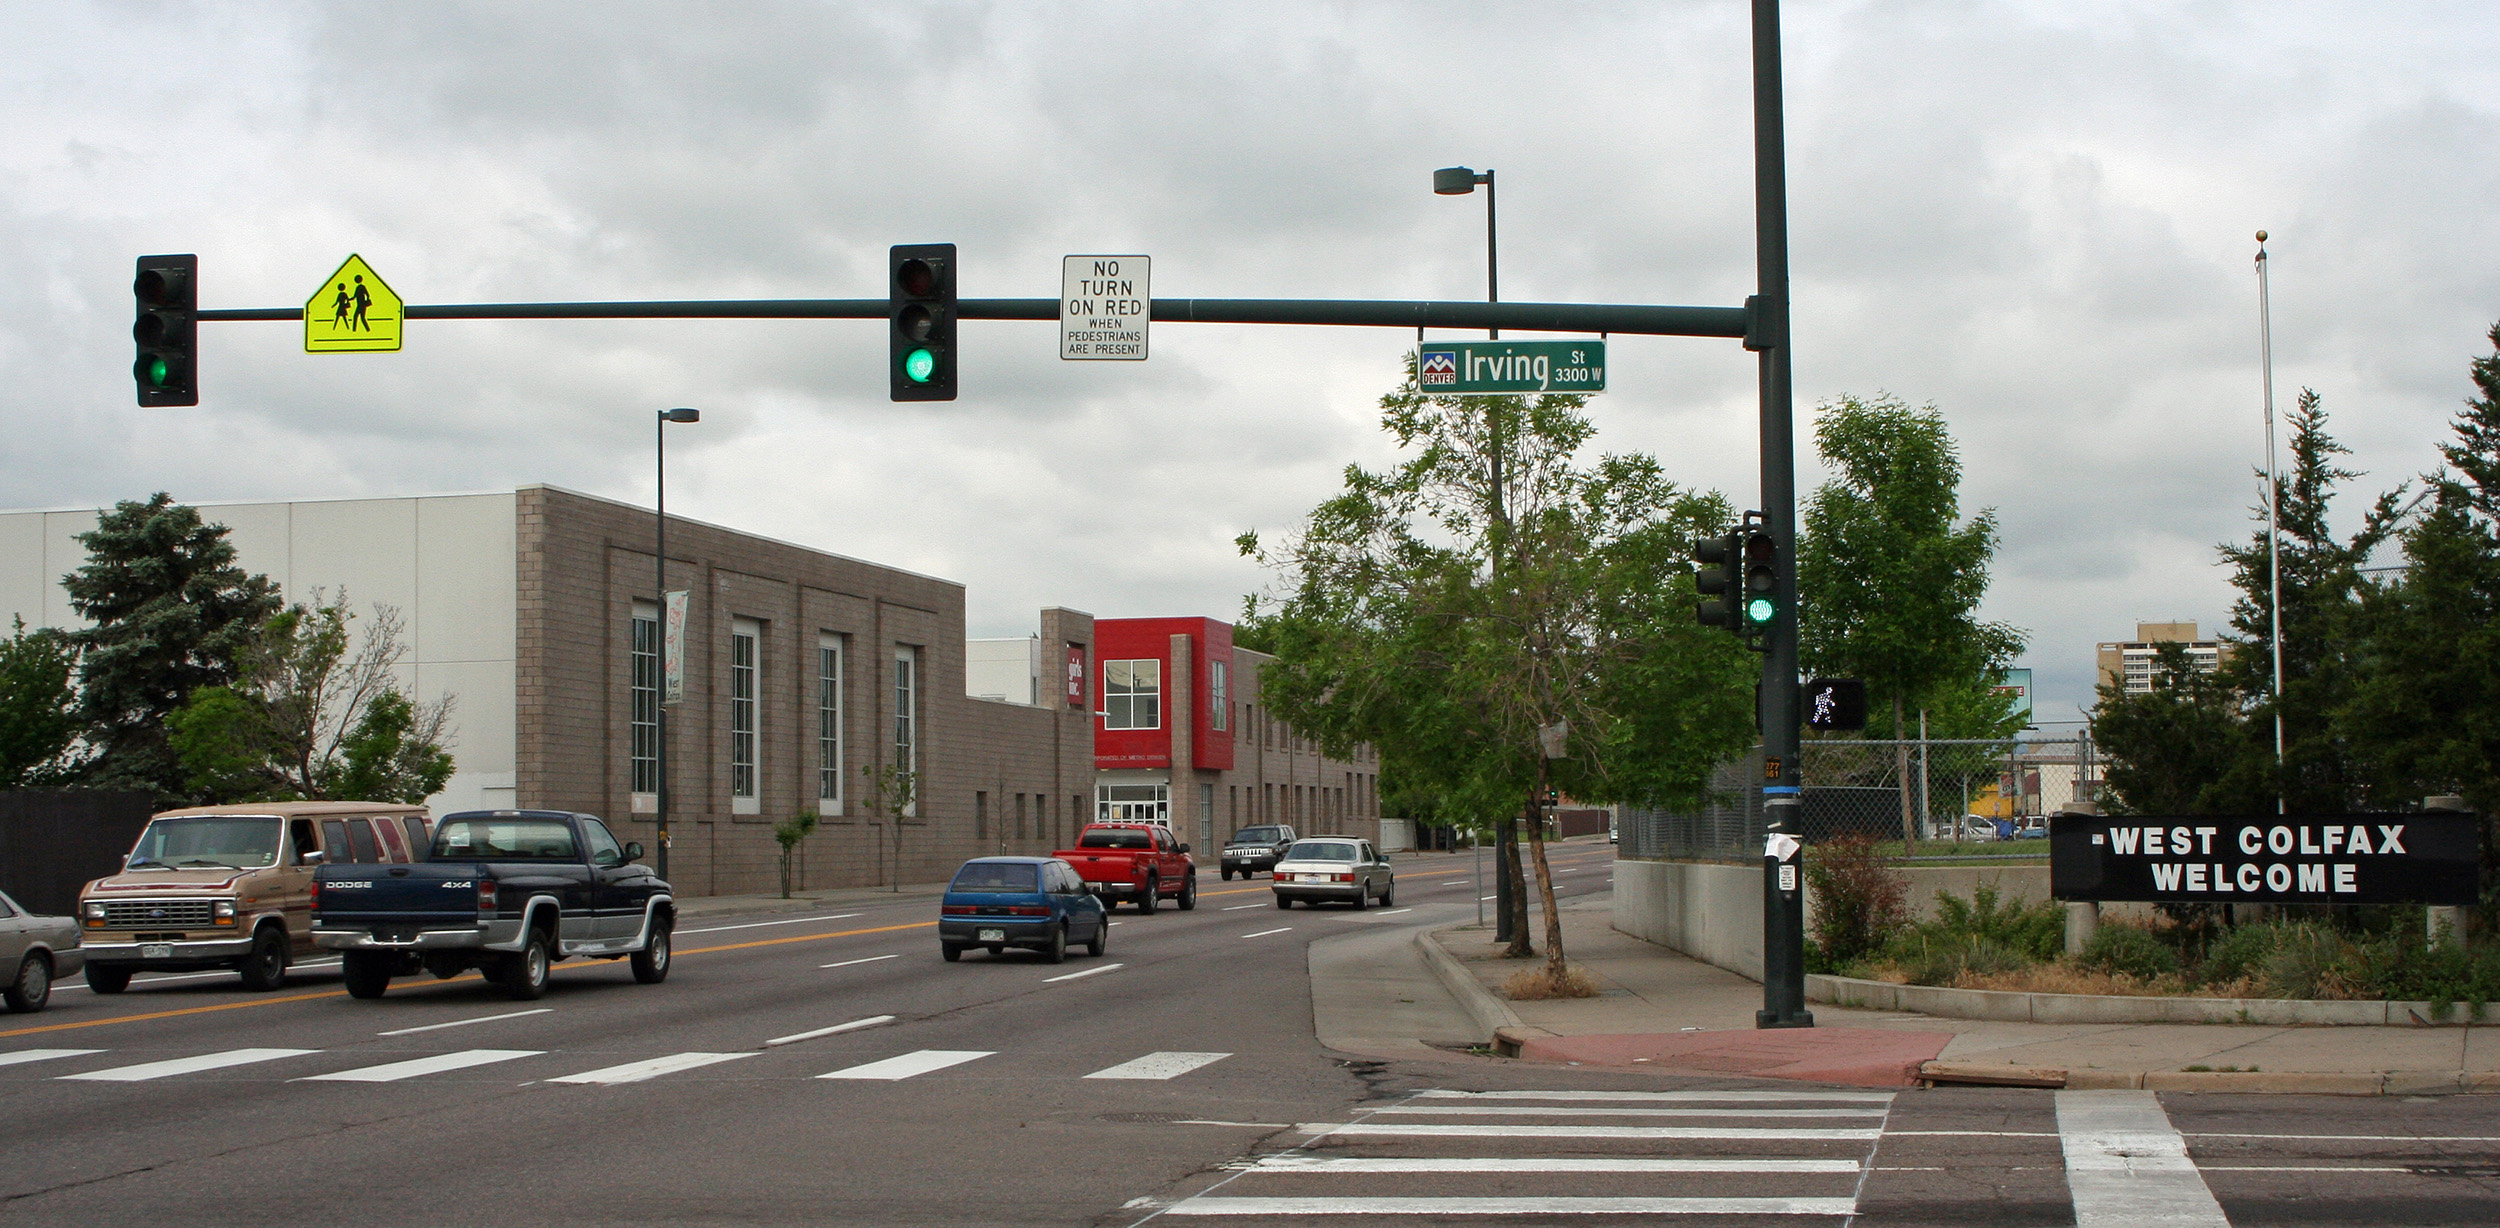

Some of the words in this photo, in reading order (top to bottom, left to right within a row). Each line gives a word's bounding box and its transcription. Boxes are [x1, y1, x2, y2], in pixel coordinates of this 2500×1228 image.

[1094, 261, 1119, 276] NO
[1081, 280, 1132, 296] TURN
[1069, 300, 1093, 315] ON
[1105, 300, 1141, 315] RED
[1089, 318, 1122, 328] WHEN
[1068, 331, 1141, 341] PEDESTRIANS
[1068, 344, 1088, 353] ARE
[1095, 344, 1140, 354] PRESENT
[1465, 349, 1549, 391] Irving
[1571, 350, 1585, 364] St
[1555, 368, 1588, 382] 3300
[1592, 368, 1602, 381] W
[1423, 374, 1455, 384] DENVER
[2110, 826, 2217, 855] WEST
[2238, 825, 2406, 855] COLFAX
[2151, 863, 2357, 892] WELCOME
[326, 881, 372, 889] DODGE
